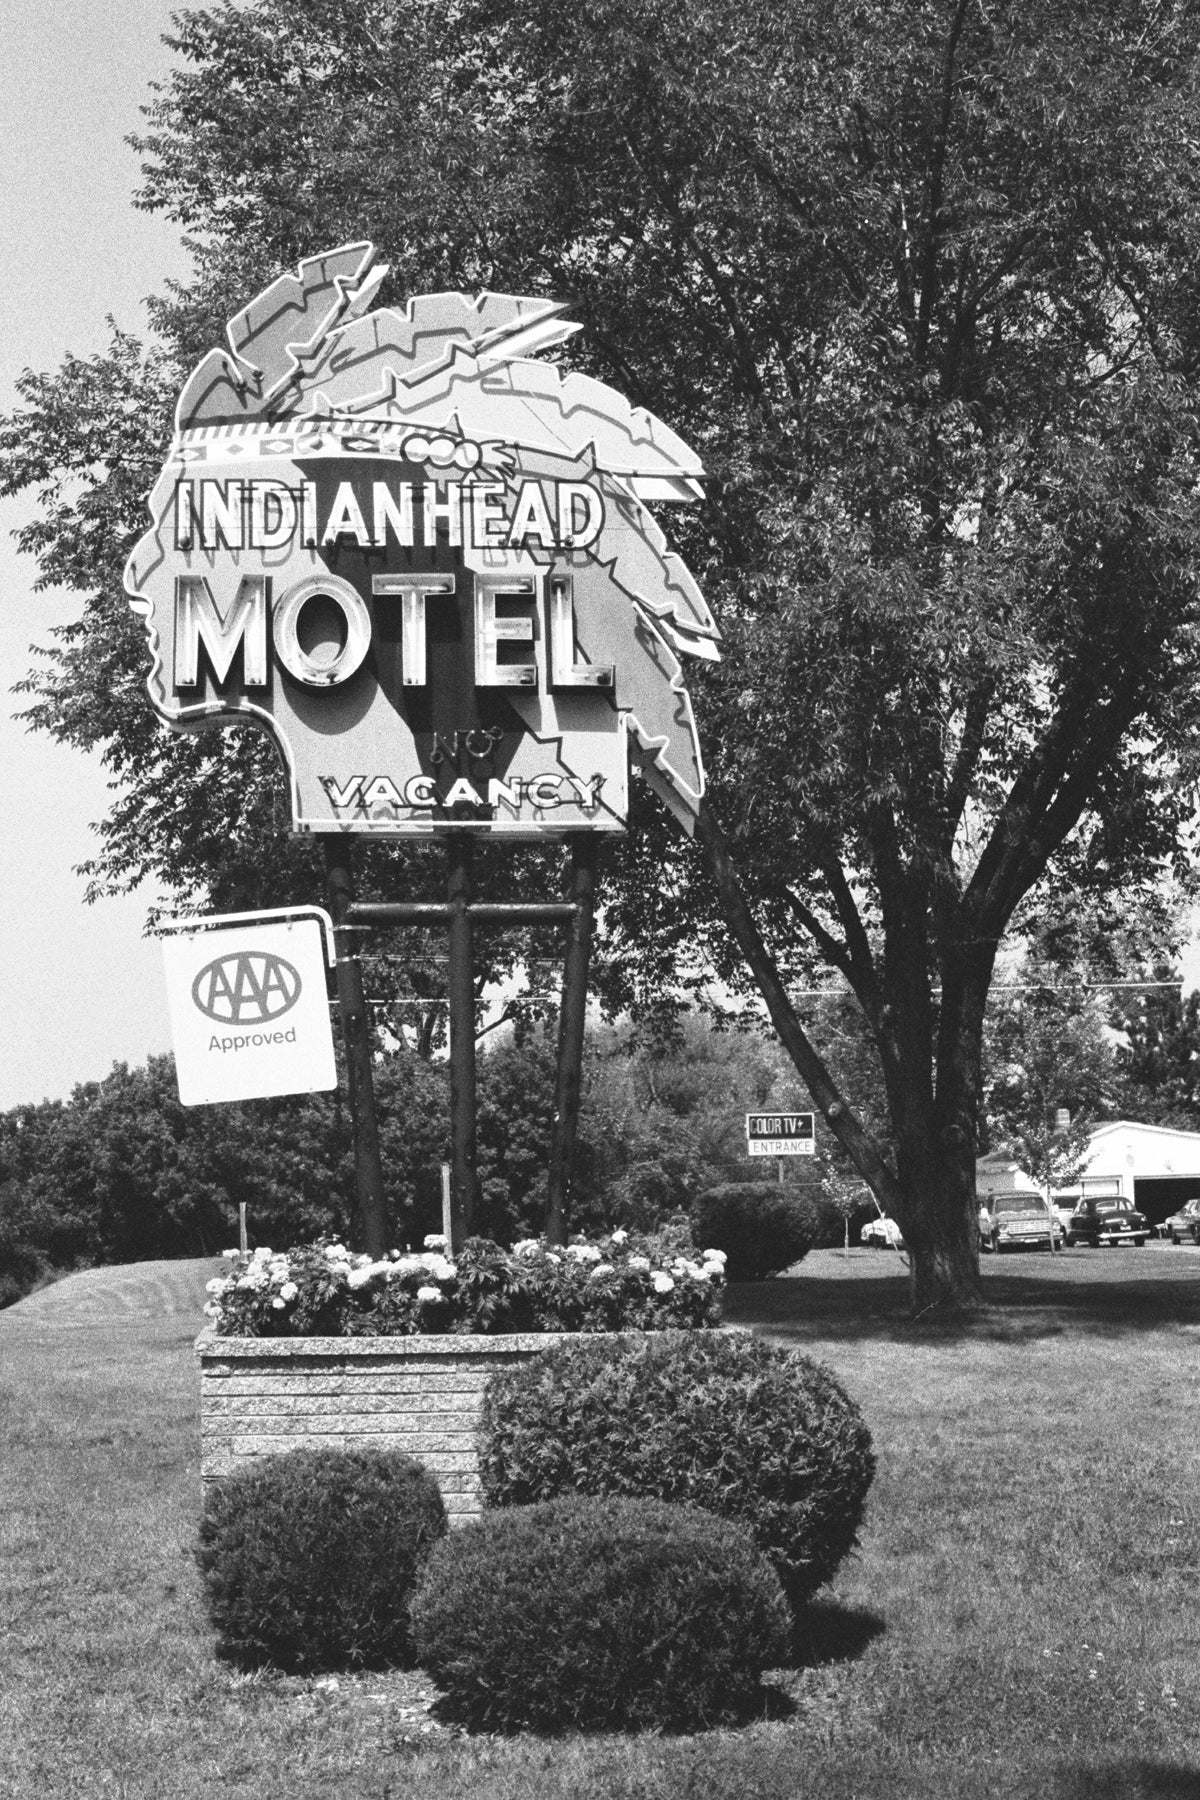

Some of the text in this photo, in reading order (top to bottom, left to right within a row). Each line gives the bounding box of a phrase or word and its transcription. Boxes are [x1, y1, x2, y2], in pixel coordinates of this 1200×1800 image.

[174, 478, 604, 550] INDIANHEAD
[174, 573, 615, 687] MOTEL
[430, 726, 503, 765] NO
[318, 773, 608, 808] VACANCY
[203, 952, 297, 1023] AAA
[209, 1027, 297, 1053] Approved
[750, 1117, 797, 1134] COLOR TV
[753, 1141, 811, 1153] ENTRANCE
